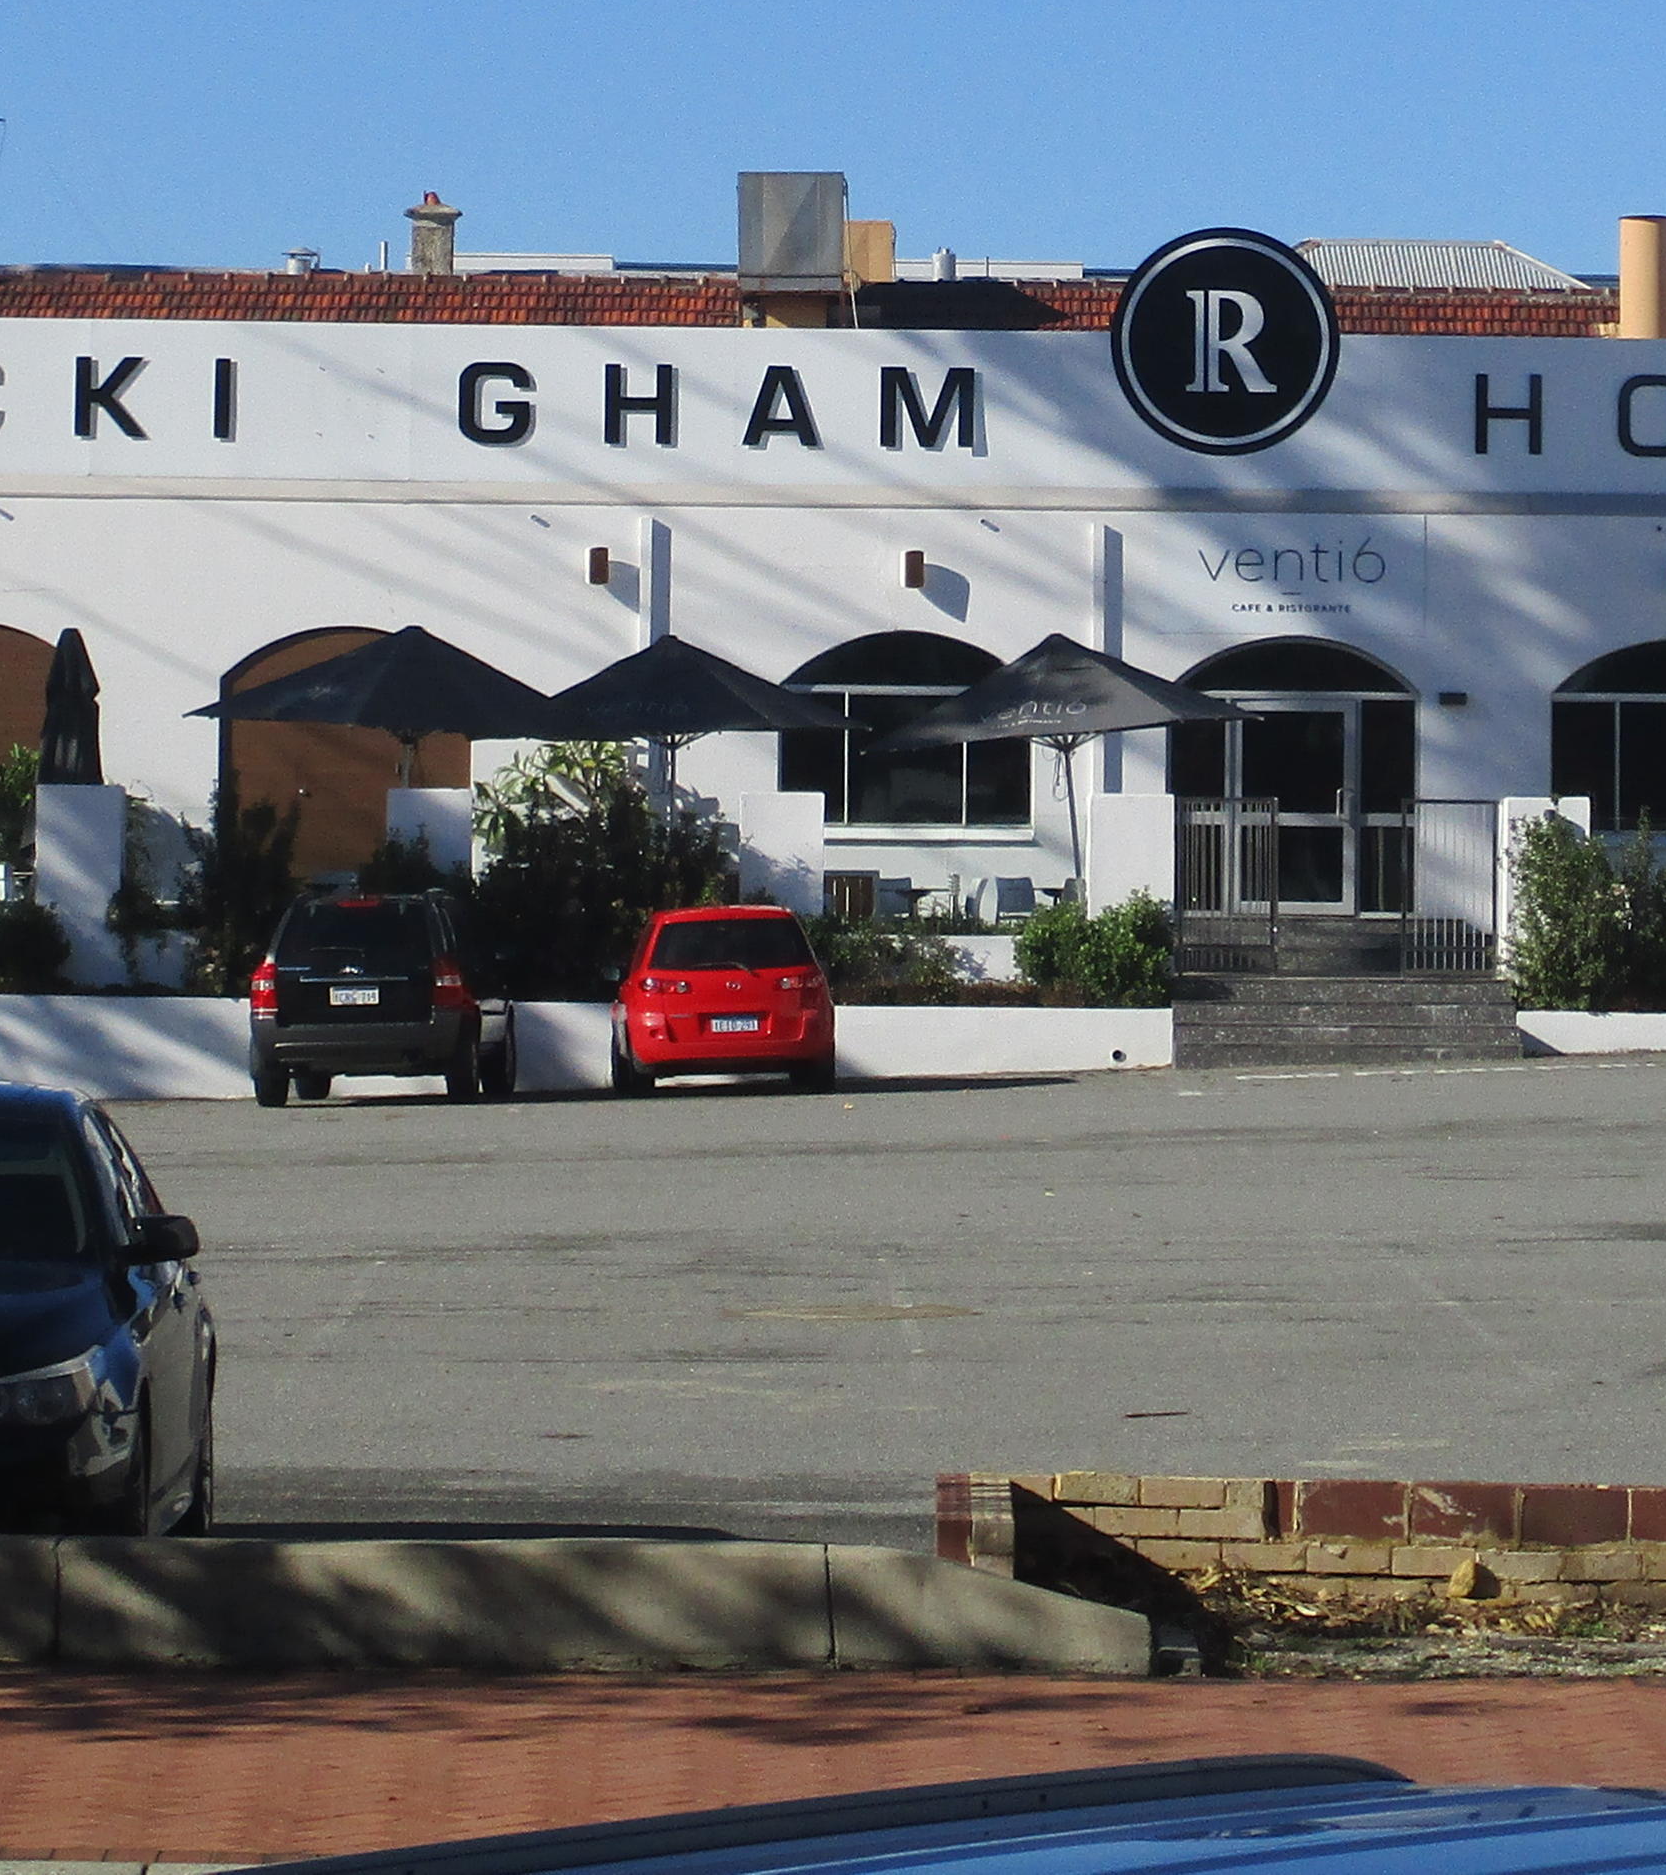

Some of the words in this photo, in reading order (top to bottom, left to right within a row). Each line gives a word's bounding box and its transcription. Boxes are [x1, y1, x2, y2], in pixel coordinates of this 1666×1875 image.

[1185, 289, 1278, 394] R
[458, 361, 978, 449] GHAM
[1231, 603, 1262, 613] CAFE
[1265, 604, 1274, 613] &
[1278, 604, 1352, 614] RISTORANTE
